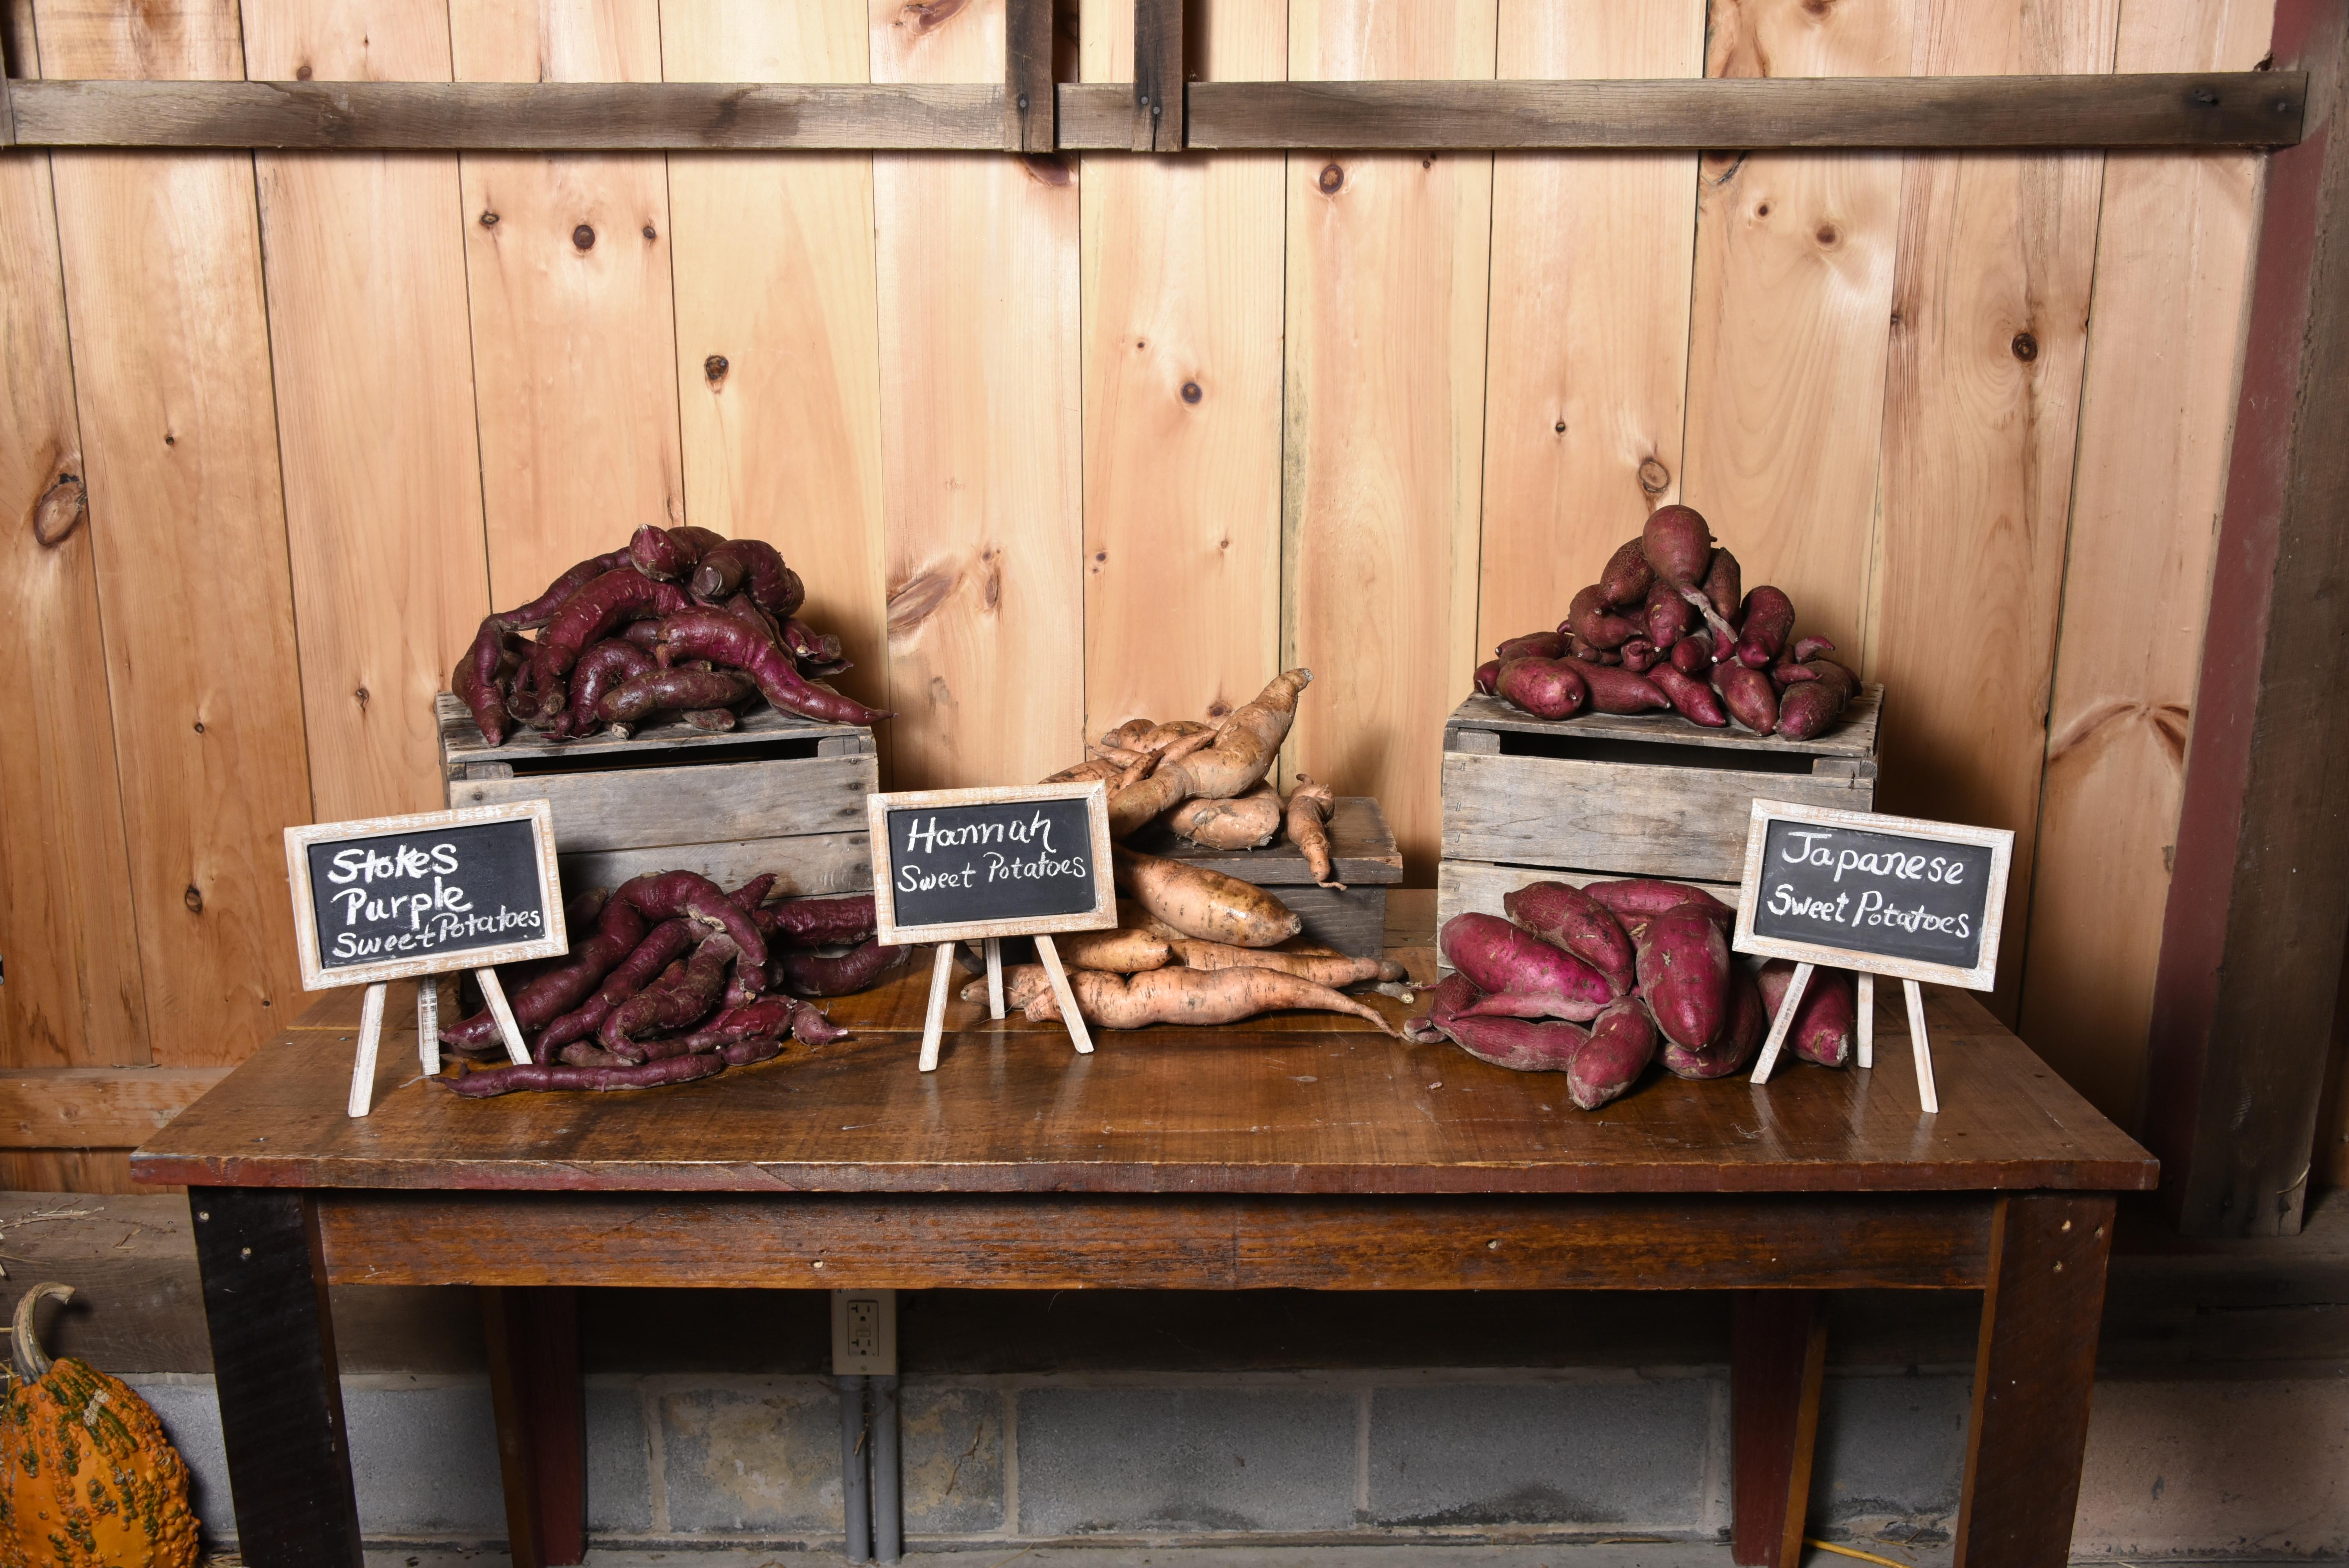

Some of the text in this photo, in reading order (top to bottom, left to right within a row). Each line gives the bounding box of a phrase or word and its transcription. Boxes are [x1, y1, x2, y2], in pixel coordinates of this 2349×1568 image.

[907, 810, 1056, 853] Hannah
[1781, 831, 1963, 884] Japanese
[897, 852, 1086, 892] Sweet Potatoes
[331, 877, 473, 931] Purple
[1767, 884, 1970, 938] Sweet Potatoes
[332, 905, 540, 958] Sweet Potatoes
